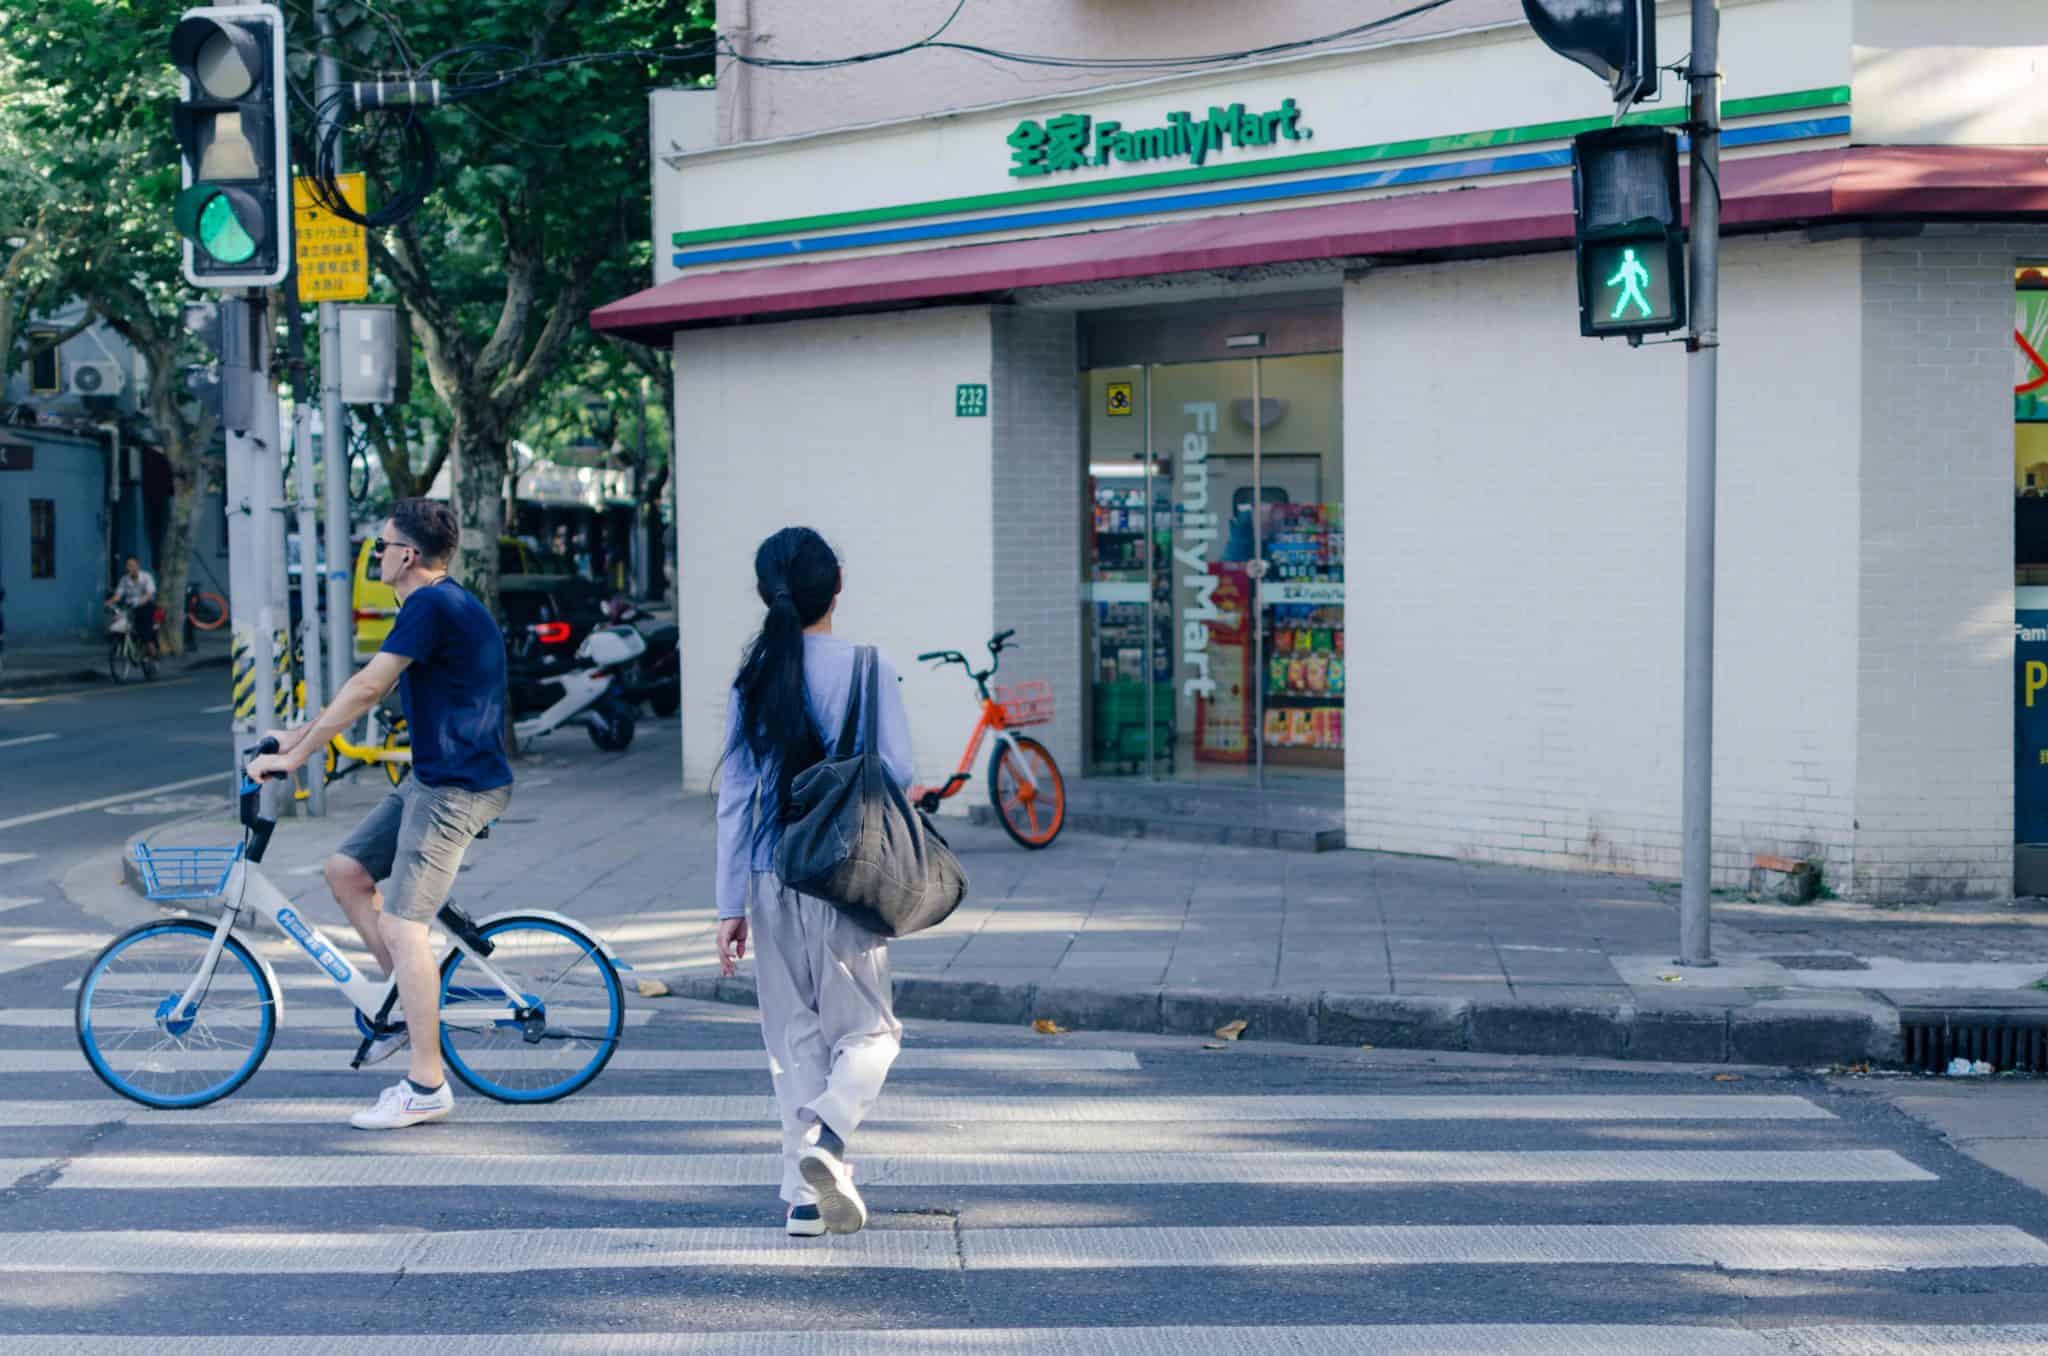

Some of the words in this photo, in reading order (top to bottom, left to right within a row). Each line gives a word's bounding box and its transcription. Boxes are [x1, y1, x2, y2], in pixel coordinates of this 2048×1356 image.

[1006, 113, 1091, 177] 全家
[1096, 97, 1299, 165] FamilyMart
[1174, 401, 1218, 699] FamilyMart
